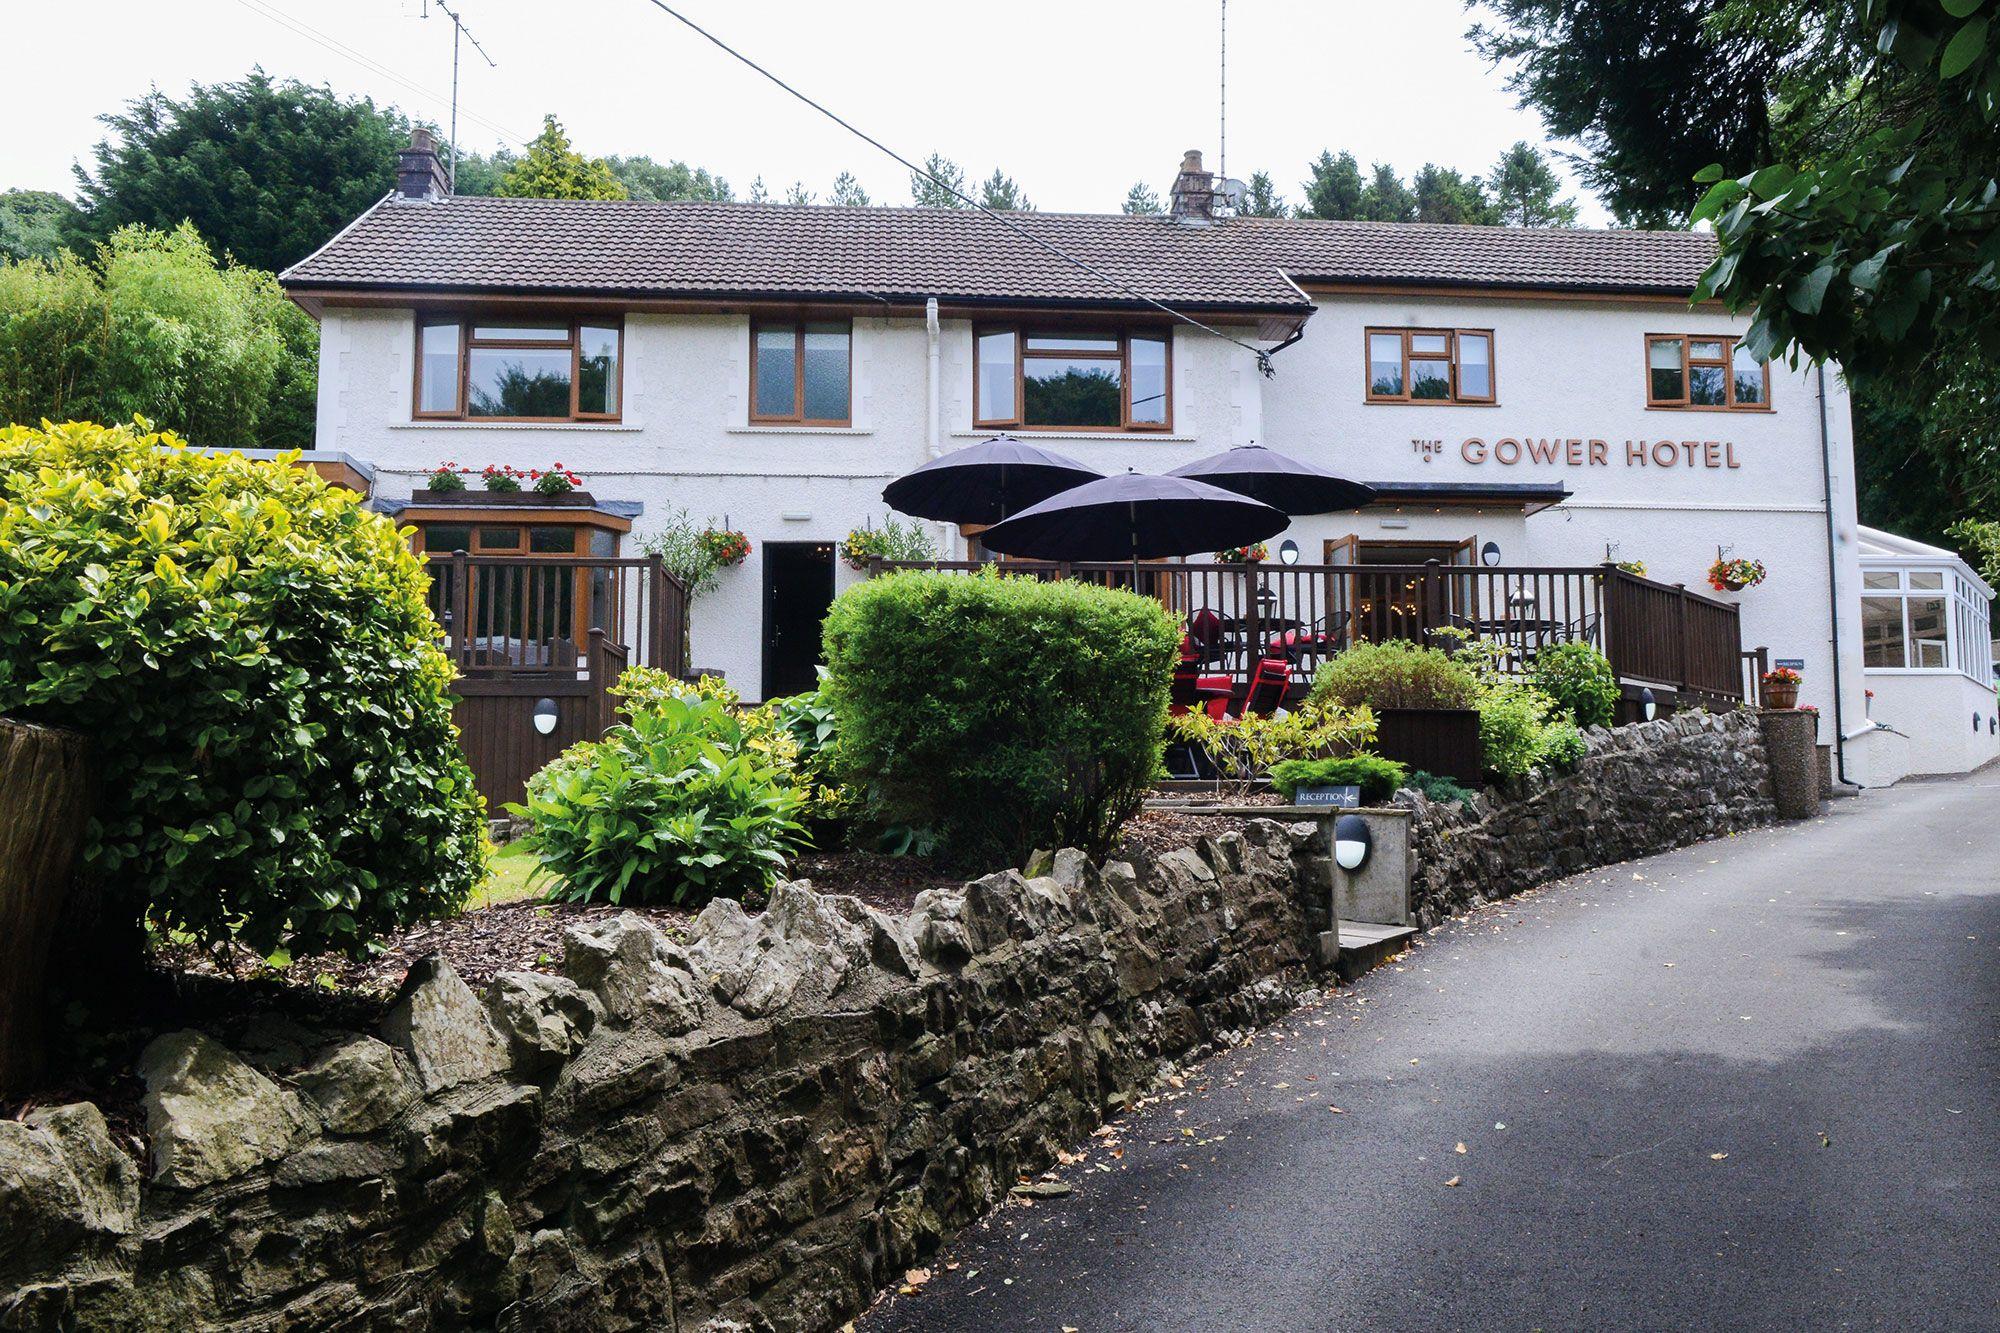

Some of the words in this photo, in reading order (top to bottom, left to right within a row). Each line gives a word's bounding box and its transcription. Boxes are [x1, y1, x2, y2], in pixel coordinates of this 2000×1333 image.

[1412, 439, 1442, 454] THE
[1461, 437, 1609, 466] GOWER
[1626, 440, 1741, 469] HOTEL
[1299, 792, 1345, 801] RECEPTION
